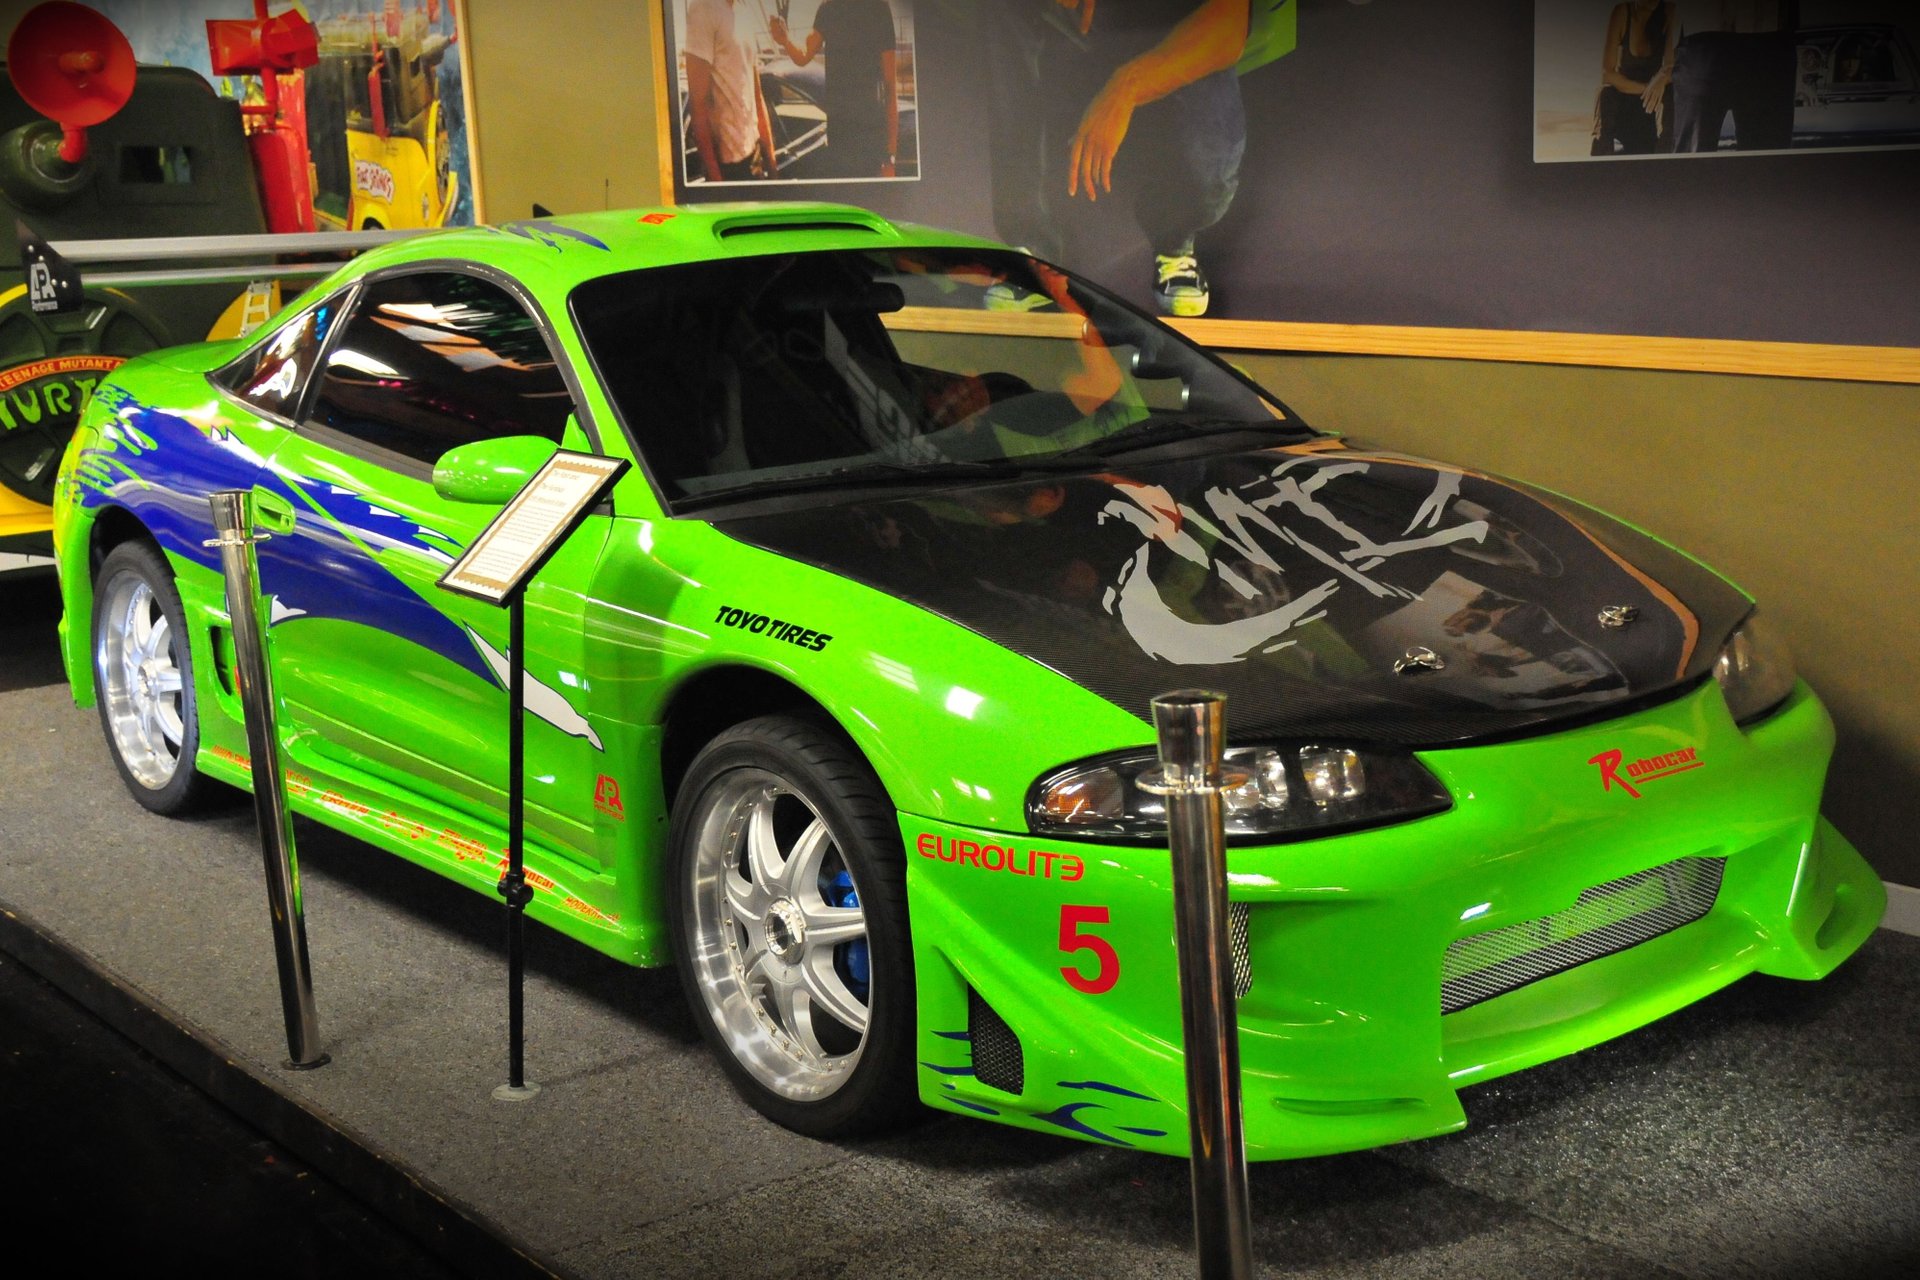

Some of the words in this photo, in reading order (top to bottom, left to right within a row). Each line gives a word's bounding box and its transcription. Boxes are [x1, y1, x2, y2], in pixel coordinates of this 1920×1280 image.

[59, 358, 113, 370] MUTANT
[714, 605, 770, 634] TOYO
[766, 619, 834, 652] TIRES
[1586, 746, 1704, 799] Robocar
[916, 832, 1086, 882] EUROLITE
[1057, 903, 1121, 995] 5
